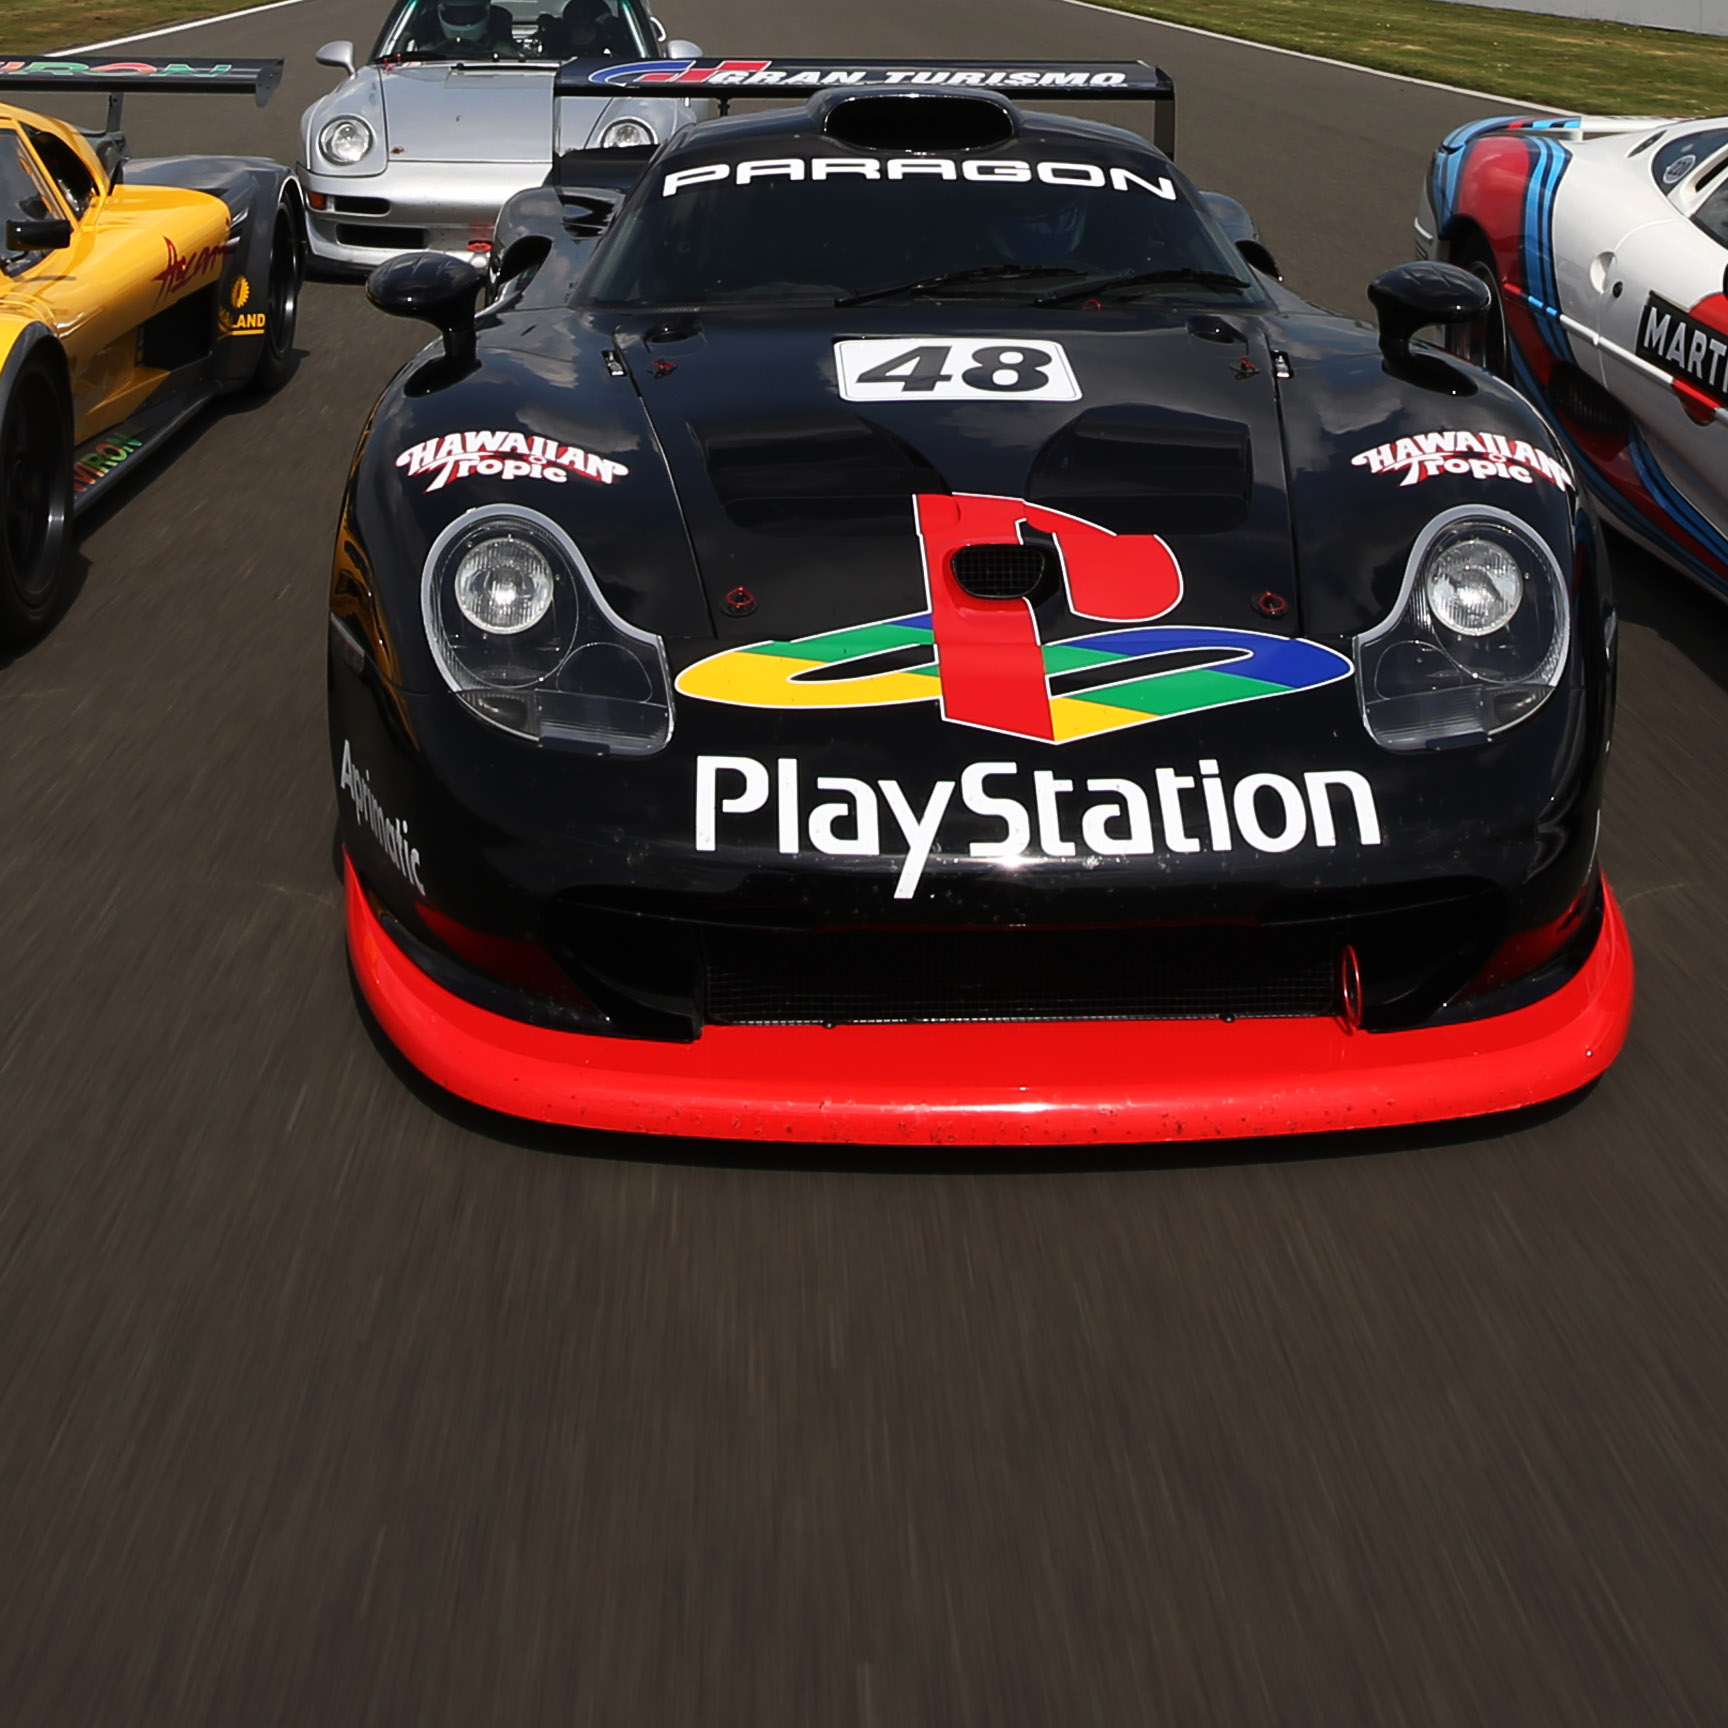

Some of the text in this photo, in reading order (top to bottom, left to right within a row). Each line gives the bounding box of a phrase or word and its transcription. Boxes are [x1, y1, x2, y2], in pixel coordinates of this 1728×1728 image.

[708, 71, 1129, 87] GRAN TURISMO
[662, 158, 1177, 201] PARAGON
[855, 344, 1053, 393] 48
[395, 430, 629, 484] HAWAIIAN
[417, 452, 568, 493] Tropic
[1351, 431, 1576, 491] HAWAIIAN
[1381, 452, 1533, 487] Tropic
[341, 739, 425, 896] Aprimatic
[695, 755, 1381, 899] PlayStation
